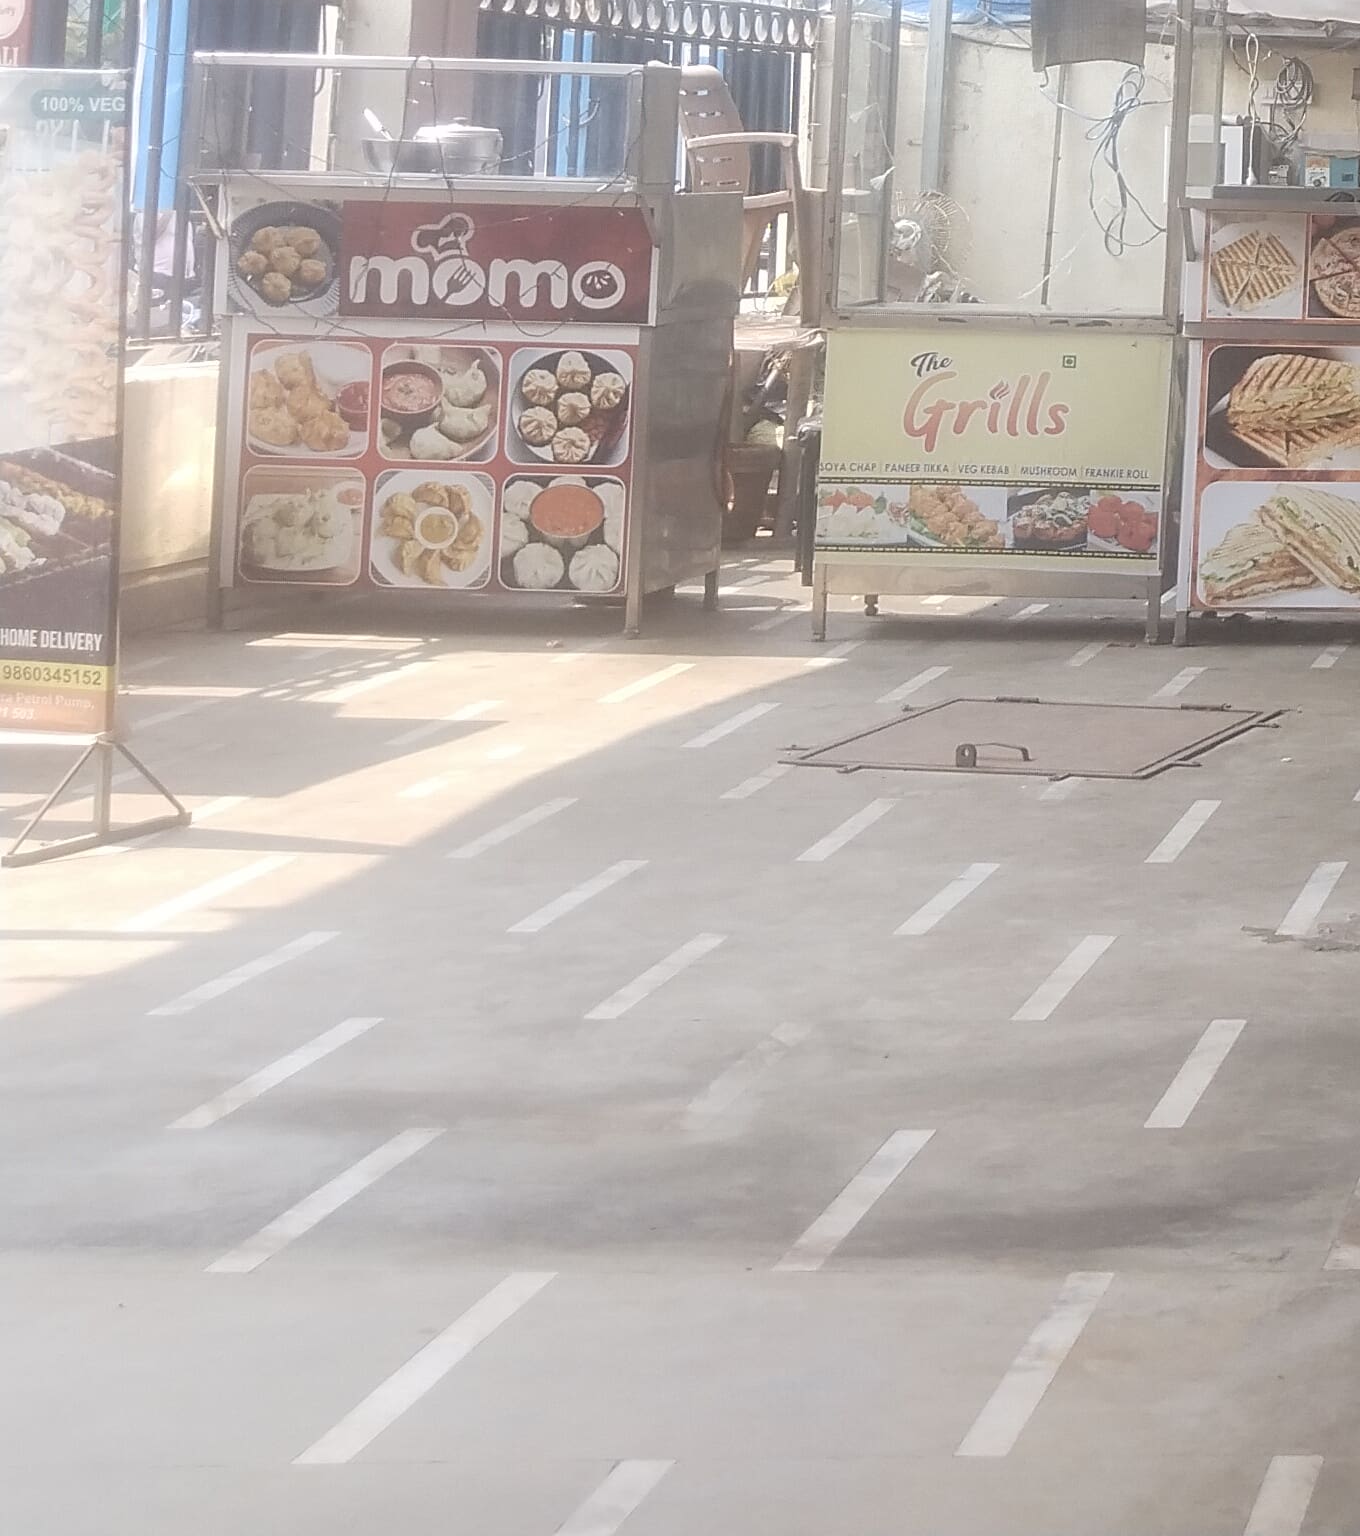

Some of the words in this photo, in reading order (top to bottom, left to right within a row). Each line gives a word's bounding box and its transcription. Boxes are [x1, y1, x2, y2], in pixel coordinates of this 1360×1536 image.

[40, 96, 85, 113] 100%
[88, 96, 126, 112] VEG
[349, 254, 626, 309] momo
[911, 351, 954, 377] The
[903, 371, 1071, 453] Grills
[818, 462, 846, 473] SOYA
[885, 463, 920, 474] PANEER
[922, 463, 950, 474] TIKKA
[958, 464, 978, 475] VEG
[980, 464, 1010, 476] KEBAB
[1020, 466, 1078, 478] MUSHROOM
[1085, 467, 1124, 479] FRANKIE
[1126, 468, 1150, 480] ROLL
[0, 628, 37, 648] HOME
[40, 630, 103, 652] DELIVERY
[3, 664, 102, 686] 9860345152
